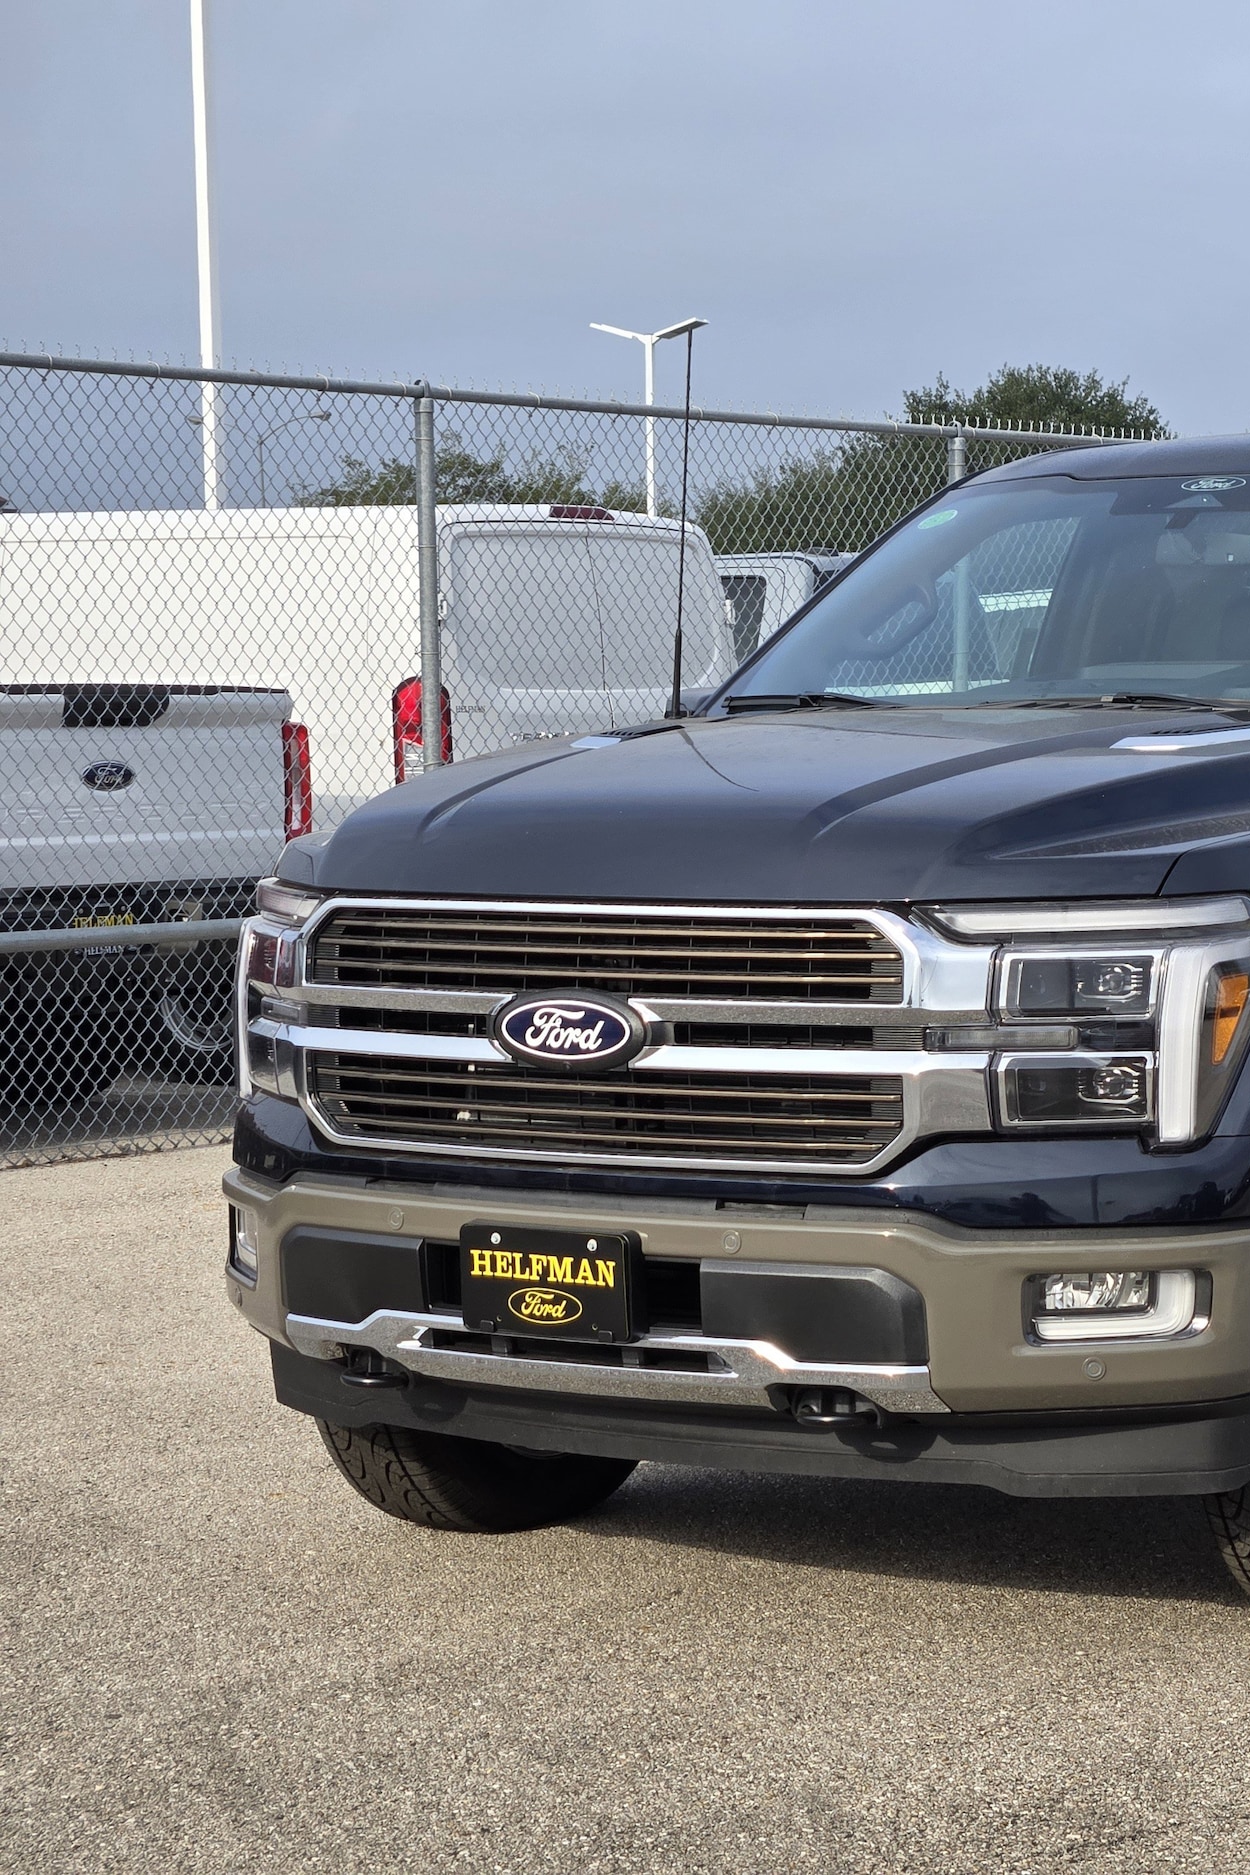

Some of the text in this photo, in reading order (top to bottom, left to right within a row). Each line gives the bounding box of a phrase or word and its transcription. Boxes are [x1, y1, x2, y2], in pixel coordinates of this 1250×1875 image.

[1190, 478, 1237, 489] Ford
[525, 1007, 605, 1050] Ford
[470, 1249, 616, 1288] HELFMAN
[520, 1290, 567, 1319] Ford
